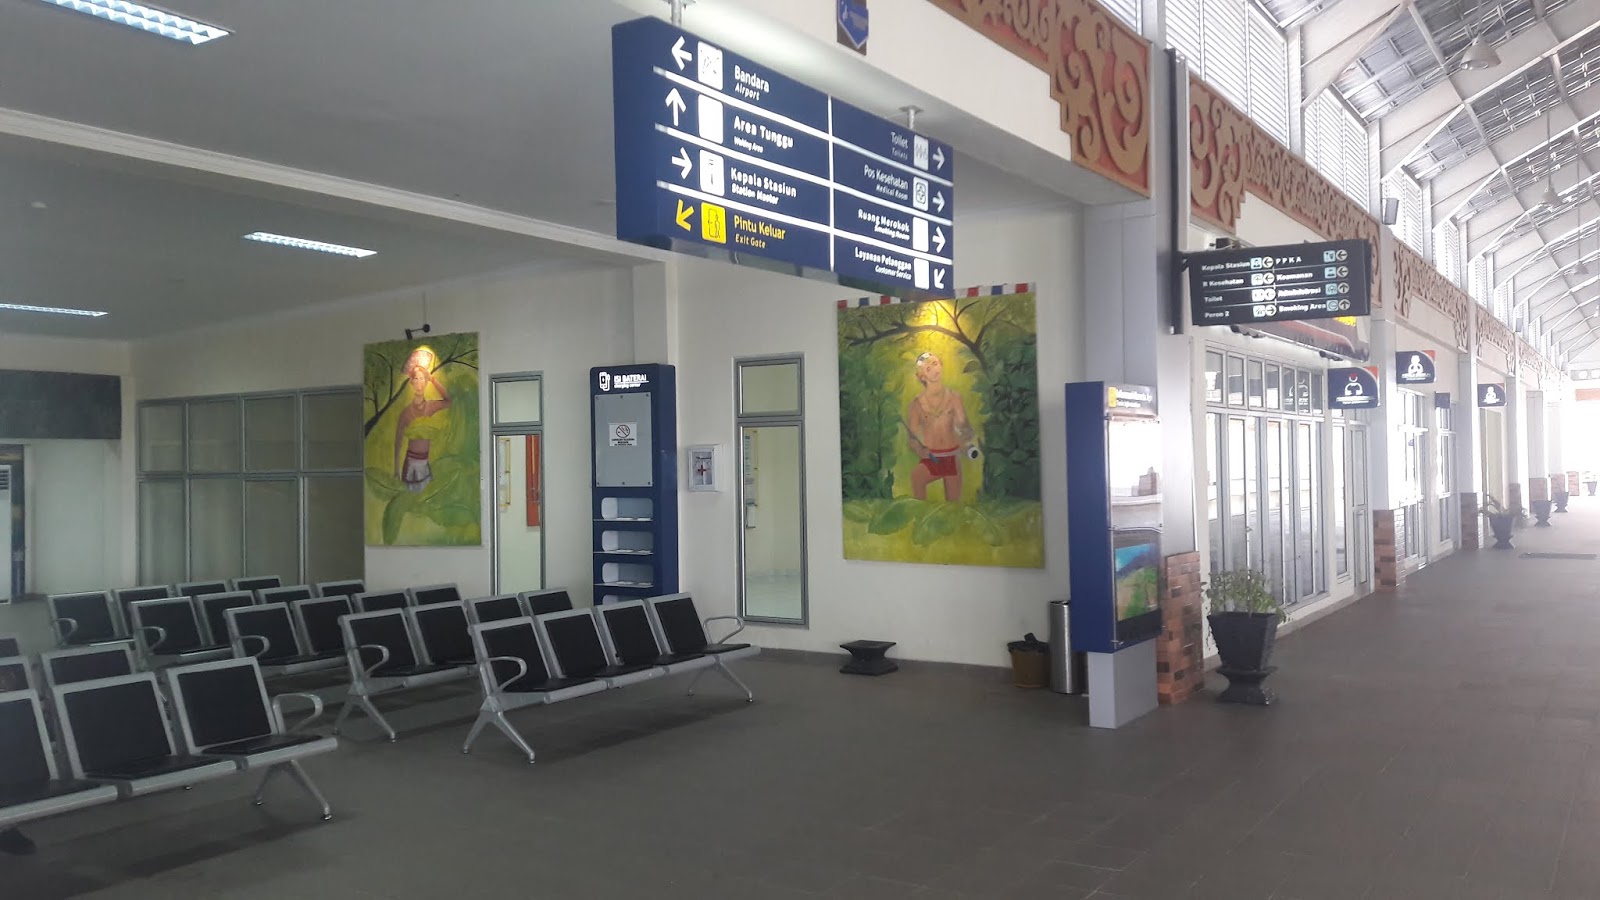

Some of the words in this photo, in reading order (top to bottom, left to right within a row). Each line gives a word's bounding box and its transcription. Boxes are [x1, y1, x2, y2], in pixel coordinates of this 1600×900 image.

[735, 65, 769, 93] Bandara
[735, 83, 760, 101] Airport
[734, 115, 757, 136] Area
[760, 125, 794, 149] Tunggu
[891, 131, 909, 150] Toilet
[730, 167, 762, 188] Kepala
[763, 177, 797, 198] Stasiun
[864, 164, 876, 179] Pos
[875, 168, 909, 190] Kesehatan
[731, 183, 756, 198] Station
[756, 189, 779, 205] Master
[875, 183, 895, 197] Medical
[894, 189, 909, 201] Room
[733, 215, 757, 233] Pintu
[758, 221, 786, 240] Keluar
[857, 208, 881, 225] Ruang
[880, 215, 910, 233] Merokok
[735, 234, 750, 245] Exit
[750, 237, 766, 249] Gate
[854, 246, 881, 262] Layanan
[881, 254, 912, 272] Pelanggan
[1201, 263, 1225, 272] Kepala
[1225, 261, 1251, 269] Stasiun
[875, 264, 897, 277] Customer
[896, 270, 912, 280] Service
[1209, 278, 1245, 287] Kesehatan
[1204, 295, 1223, 303] Toilet
[1278, 304, 1309, 313] Smoking
[622, 373, 647, 383] BATERAI
